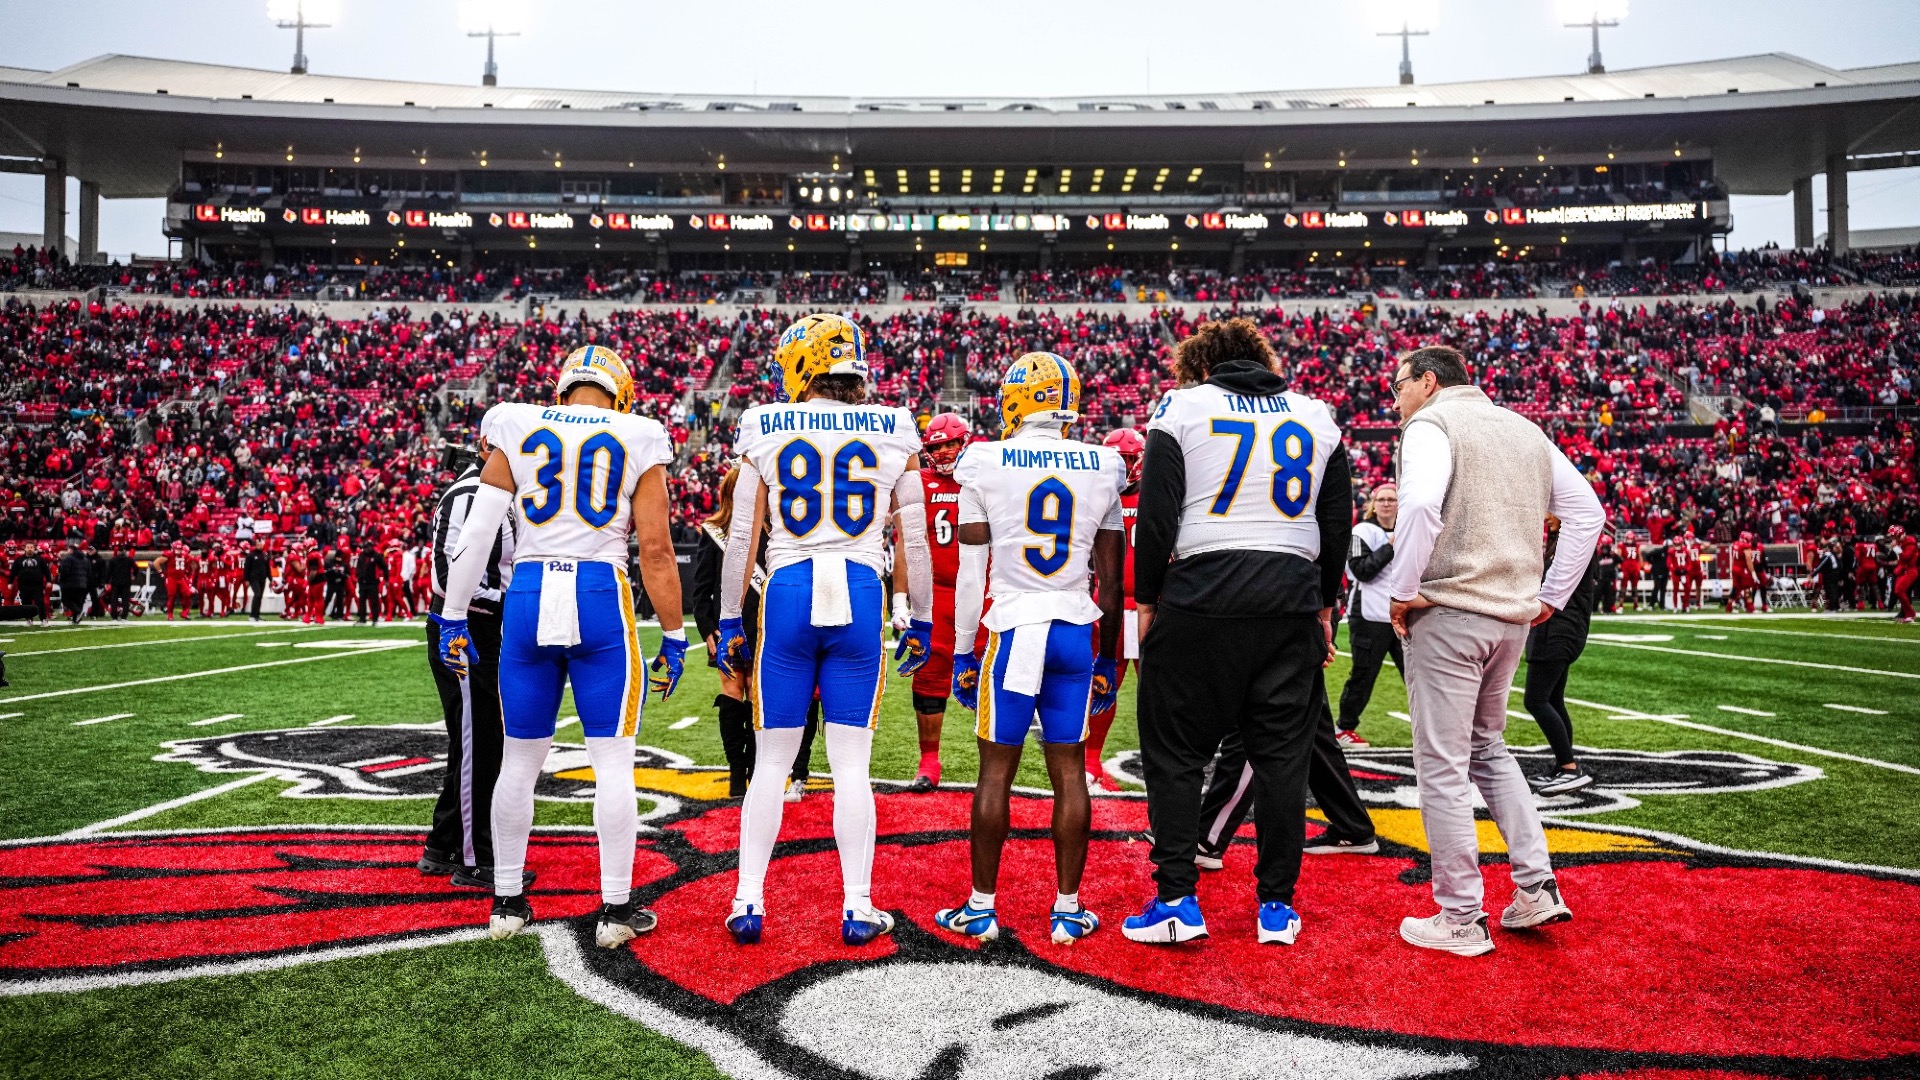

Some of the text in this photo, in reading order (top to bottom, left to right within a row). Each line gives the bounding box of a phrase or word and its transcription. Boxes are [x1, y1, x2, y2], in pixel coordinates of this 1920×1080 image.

[221, 207, 266, 223] Health
[326, 209, 370, 226] Health
[429, 212, 473, 228] Health
[530, 213, 574, 229] Health
[631, 214, 674, 230] Health
[731, 214, 775, 230] Health
[1127, 214, 1169, 230] Health
[1226, 214, 1268, 230] Health
[1325, 212, 1369, 228] Health
[1425, 210, 1468, 226] Health
[593, 355, 606, 367] 30
[1223, 394, 1292, 414] TAYLOR
[760, 410, 896, 436] BARTHOLOMEW
[1002, 448, 1100, 471] MUMPFIELD
[1207, 416, 1316, 521] 78
[519, 425, 628, 532] 30
[775, 435, 880, 540] 86
[934, 509, 954, 545] 6
[1021, 474, 1076, 579] 9
[546, 561, 575, 573] Pitt
[1451, 927, 1480, 939] HOKA
